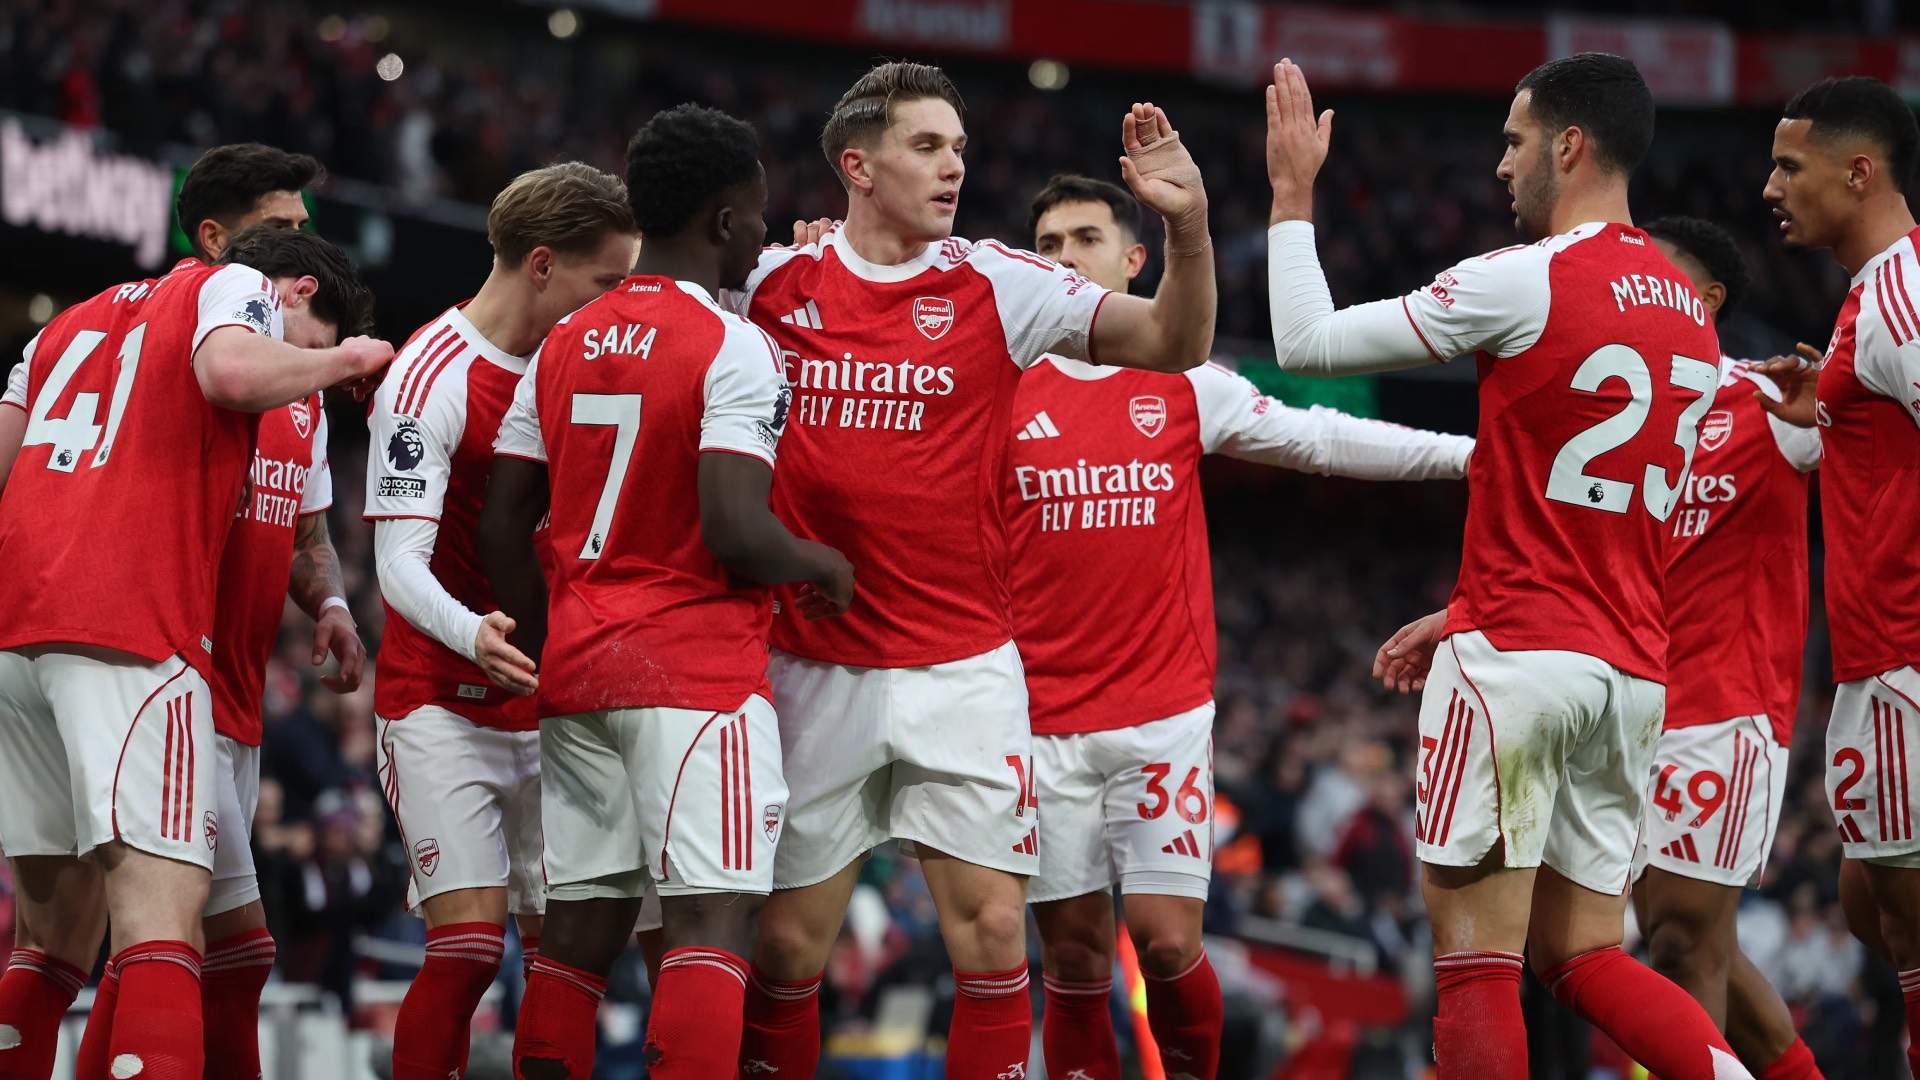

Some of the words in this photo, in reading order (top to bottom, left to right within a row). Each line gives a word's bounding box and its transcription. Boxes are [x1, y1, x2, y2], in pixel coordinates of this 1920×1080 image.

[628, 281, 662, 293] Arsenal
[918, 304, 949, 313] Arsenal
[1610, 273, 1705, 327] MERINO
[583, 323, 657, 361] SAKA
[782, 350, 955, 396] Emirates
[21, 320, 148, 474] 41
[800, 395, 834, 427] FLY
[839, 397, 925, 431] BETTER
[1544, 343, 1718, 524] 23
[250, 448, 310, 494] irates
[379, 478, 391, 488] No
[392, 480, 421, 490] room
[391, 487, 425, 498] racism
[570, 393, 643, 561] 7
[1015, 458, 1174, 501] Emirates
[255, 492, 298, 528] BETTER
[1042, 501, 1075, 532] FLY
[1081, 497, 1156, 529] BETTER
[1137, 762, 1207, 825] 36
[1653, 764, 1727, 830] 49
[1832, 747, 1866, 811] 2
